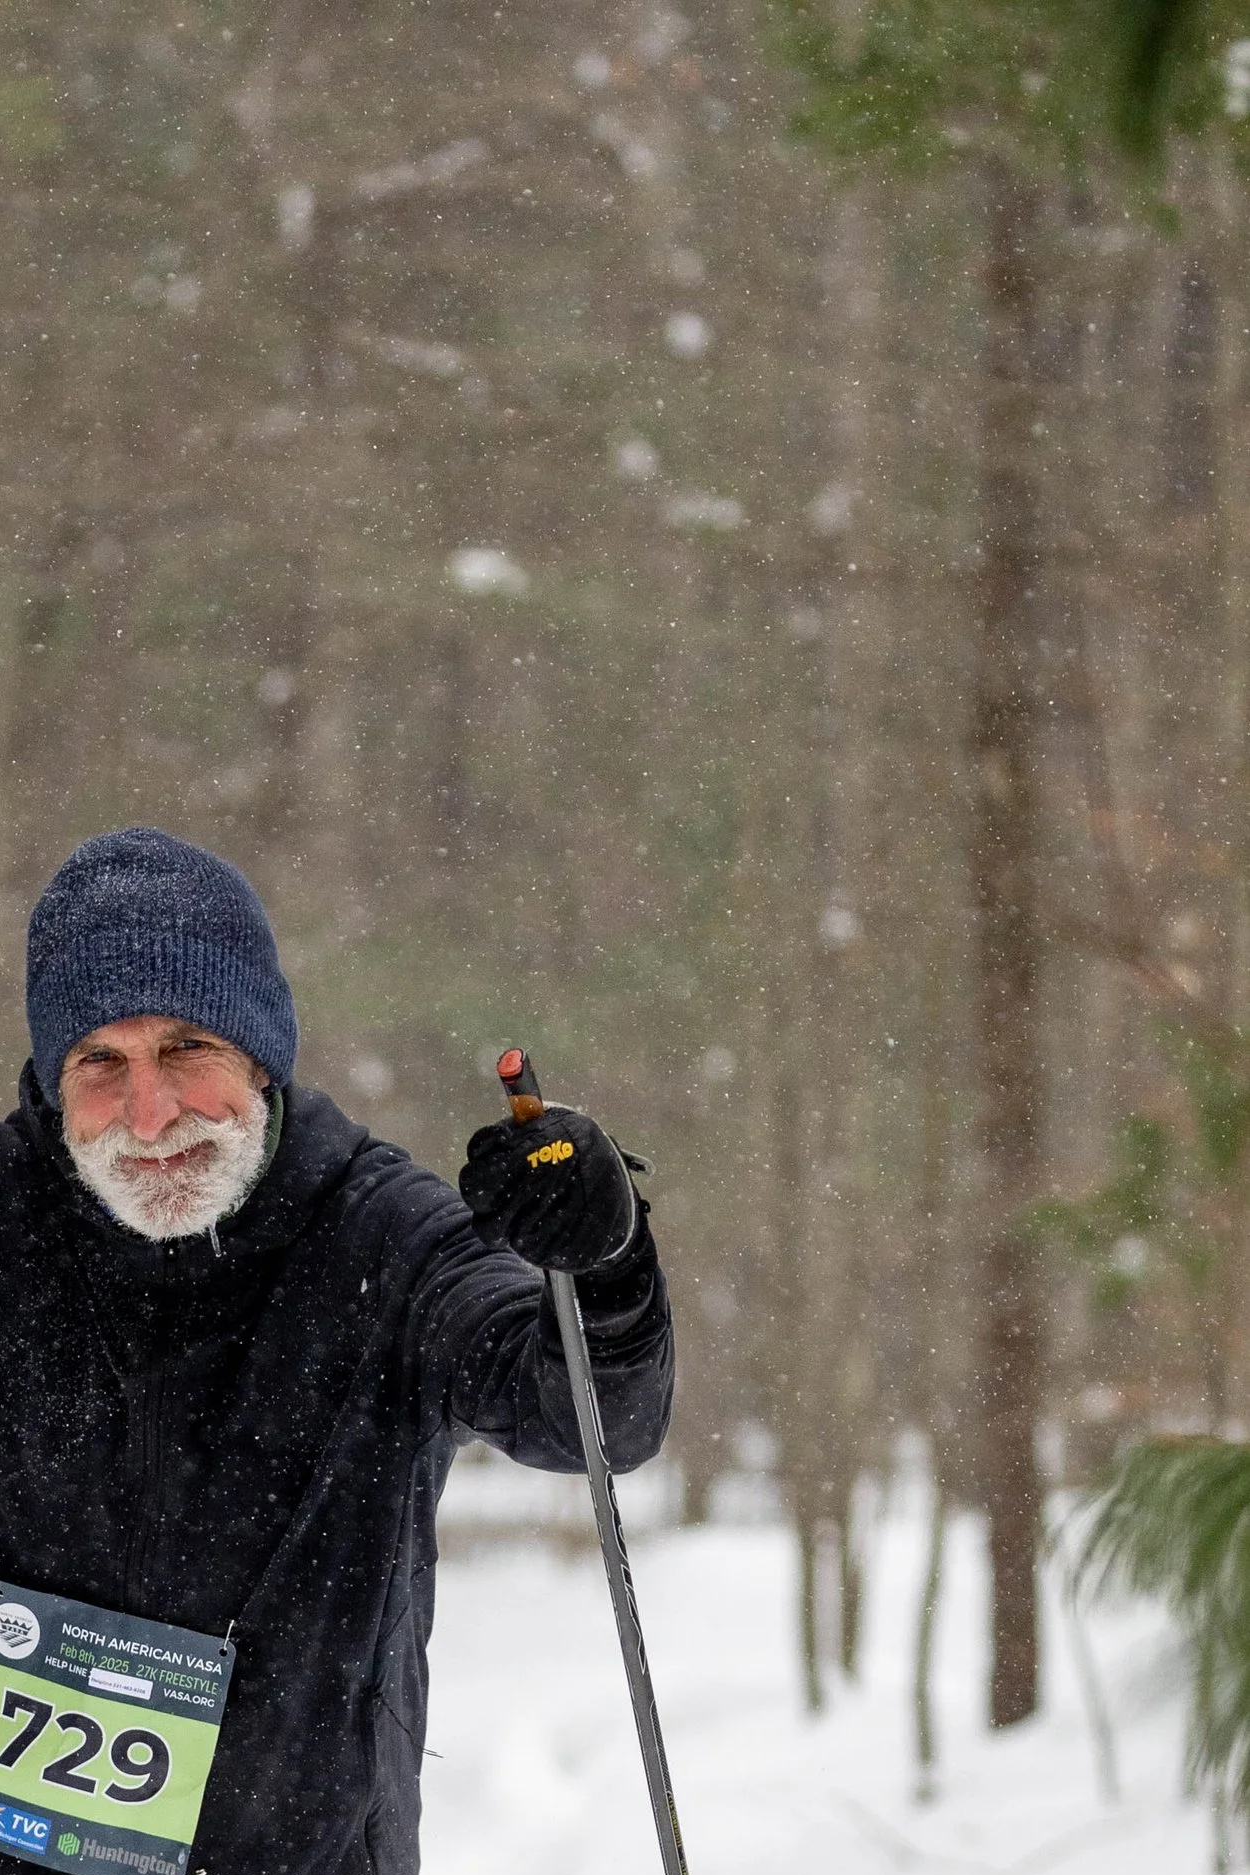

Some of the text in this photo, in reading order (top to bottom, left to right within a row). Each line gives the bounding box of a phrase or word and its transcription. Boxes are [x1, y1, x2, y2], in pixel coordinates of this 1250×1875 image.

[527, 1140, 573, 1168] TOKO
[62, 1622, 222, 1675] NORTH AMERICAN VASA
[44, 1655, 68, 1669] HELP
[59, 1642, 219, 1696] Feb 8th, 2025 27K FREESTYLE
[163, 1688, 215, 1708] VASA.ORG
[12, 1813, 48, 1838] TVC
